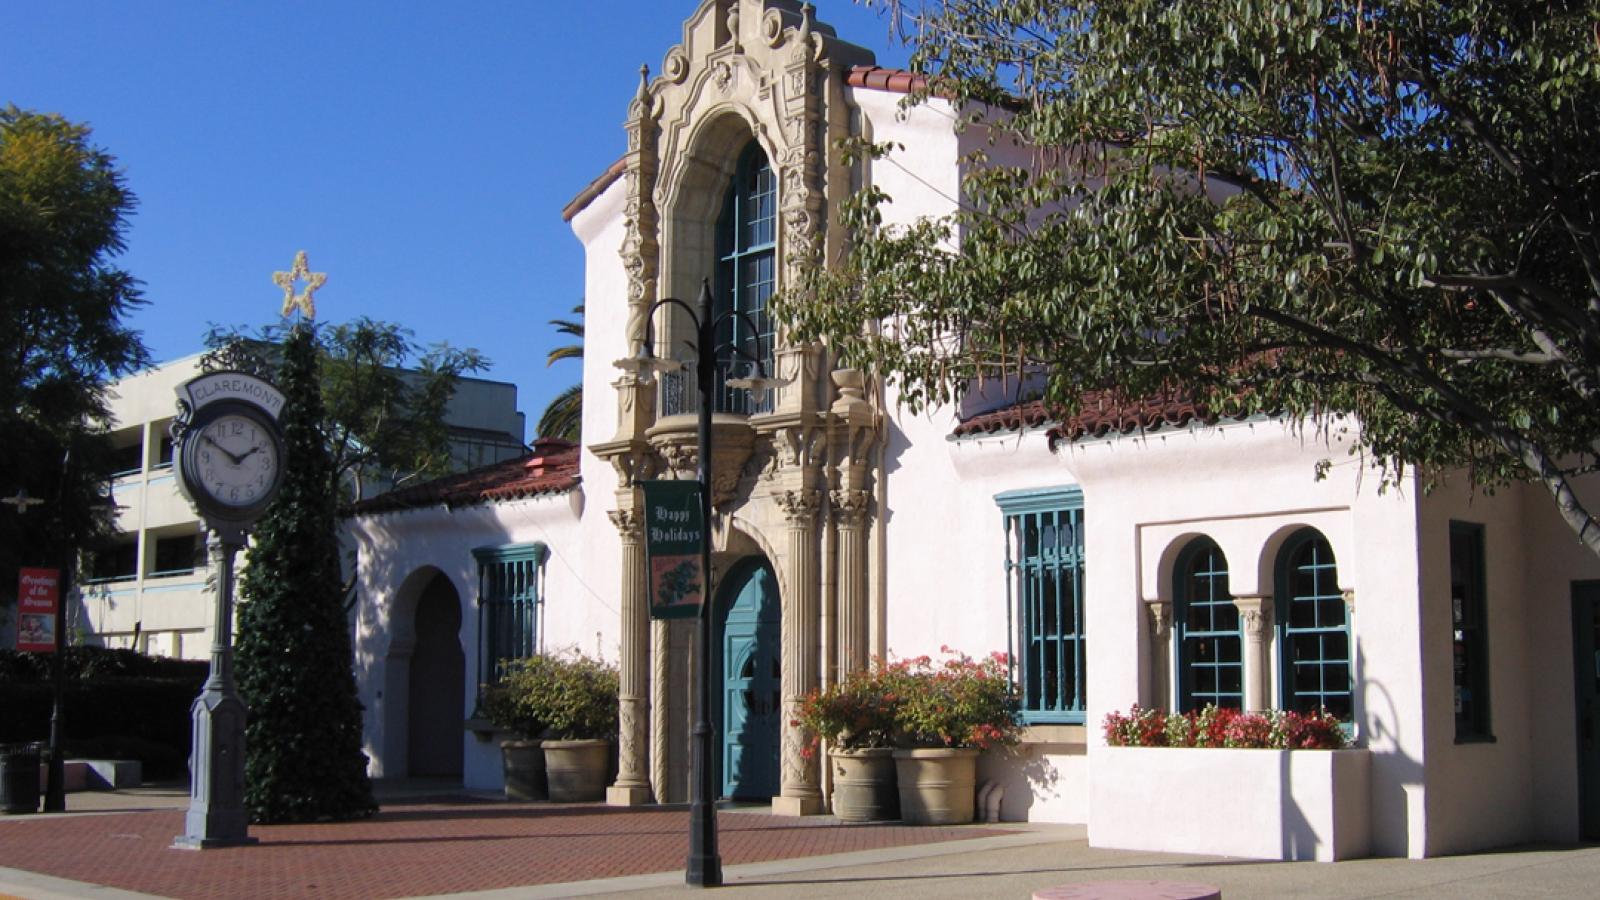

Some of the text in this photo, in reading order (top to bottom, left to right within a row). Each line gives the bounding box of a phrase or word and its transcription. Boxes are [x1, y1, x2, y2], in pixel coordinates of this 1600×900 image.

[196, 380, 281, 408] CLAREMONT
[217, 423, 226, 437] 11
[232, 422, 244, 435] 12
[258, 440, 267, 454] 2
[201, 450, 210, 464] 9
[262, 457, 271, 471] 3
[255, 474, 264, 487] 4
[215, 482, 225, 497] 7
[230, 487, 239, 502] 6
[246, 483, 255, 497] 5
[655, 506, 690, 523] Happy
[650, 526, 701, 544] Holidays
